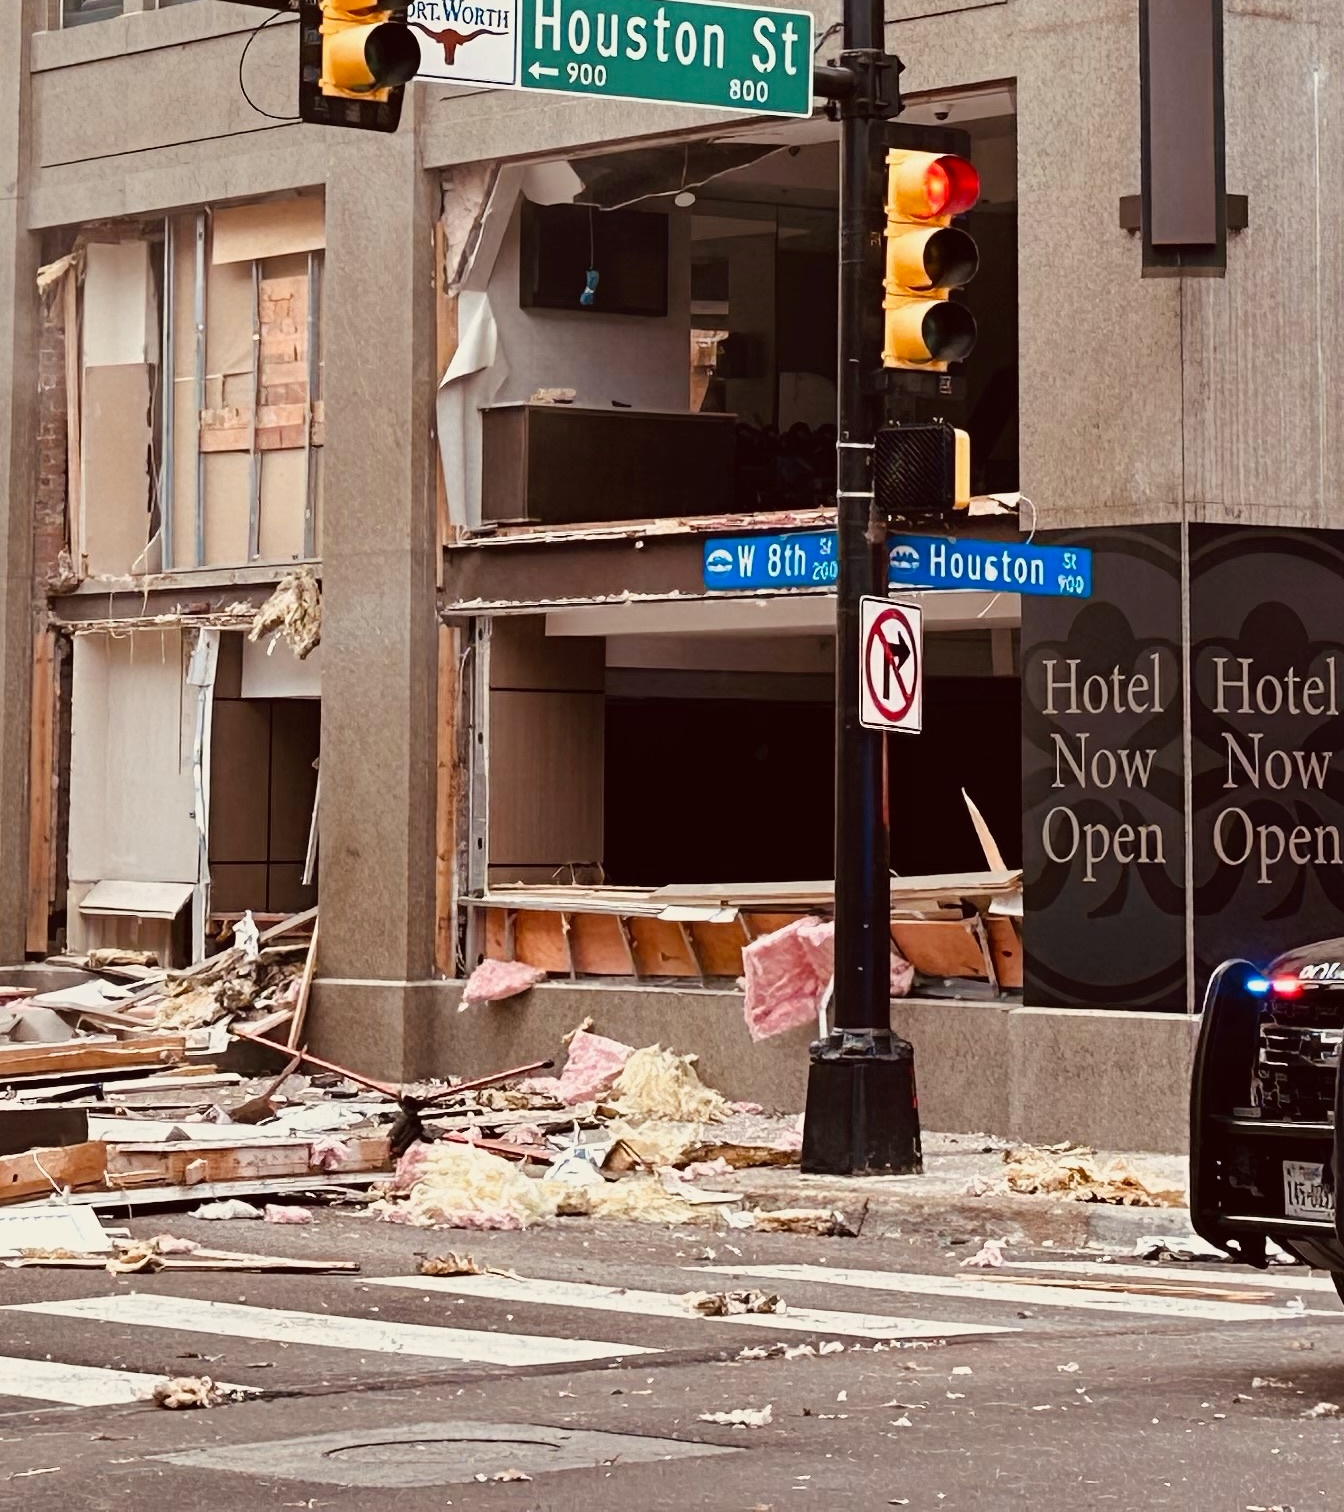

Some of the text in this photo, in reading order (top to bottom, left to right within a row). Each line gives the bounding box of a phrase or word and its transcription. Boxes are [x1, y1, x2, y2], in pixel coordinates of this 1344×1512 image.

[407, 1, 439, 21] ORT
[566, 62, 607, 87] 900
[752, 17, 799, 75] St
[728, 78, 769, 103] 800
[737, 544, 756, 578] W
[767, 543, 807, 577] 8th
[812, 560, 839, 581] 200
[929, 543, 1045, 586] Houston
[1041, 652, 1165, 715] Hotel
[1211, 655, 1340, 716] Hotel
[1050, 732, 1157, 789] Now
[1220, 731, 1333, 790] Now
[1041, 806, 1167, 883] Open
[1212, 806, 1344, 884] Open
